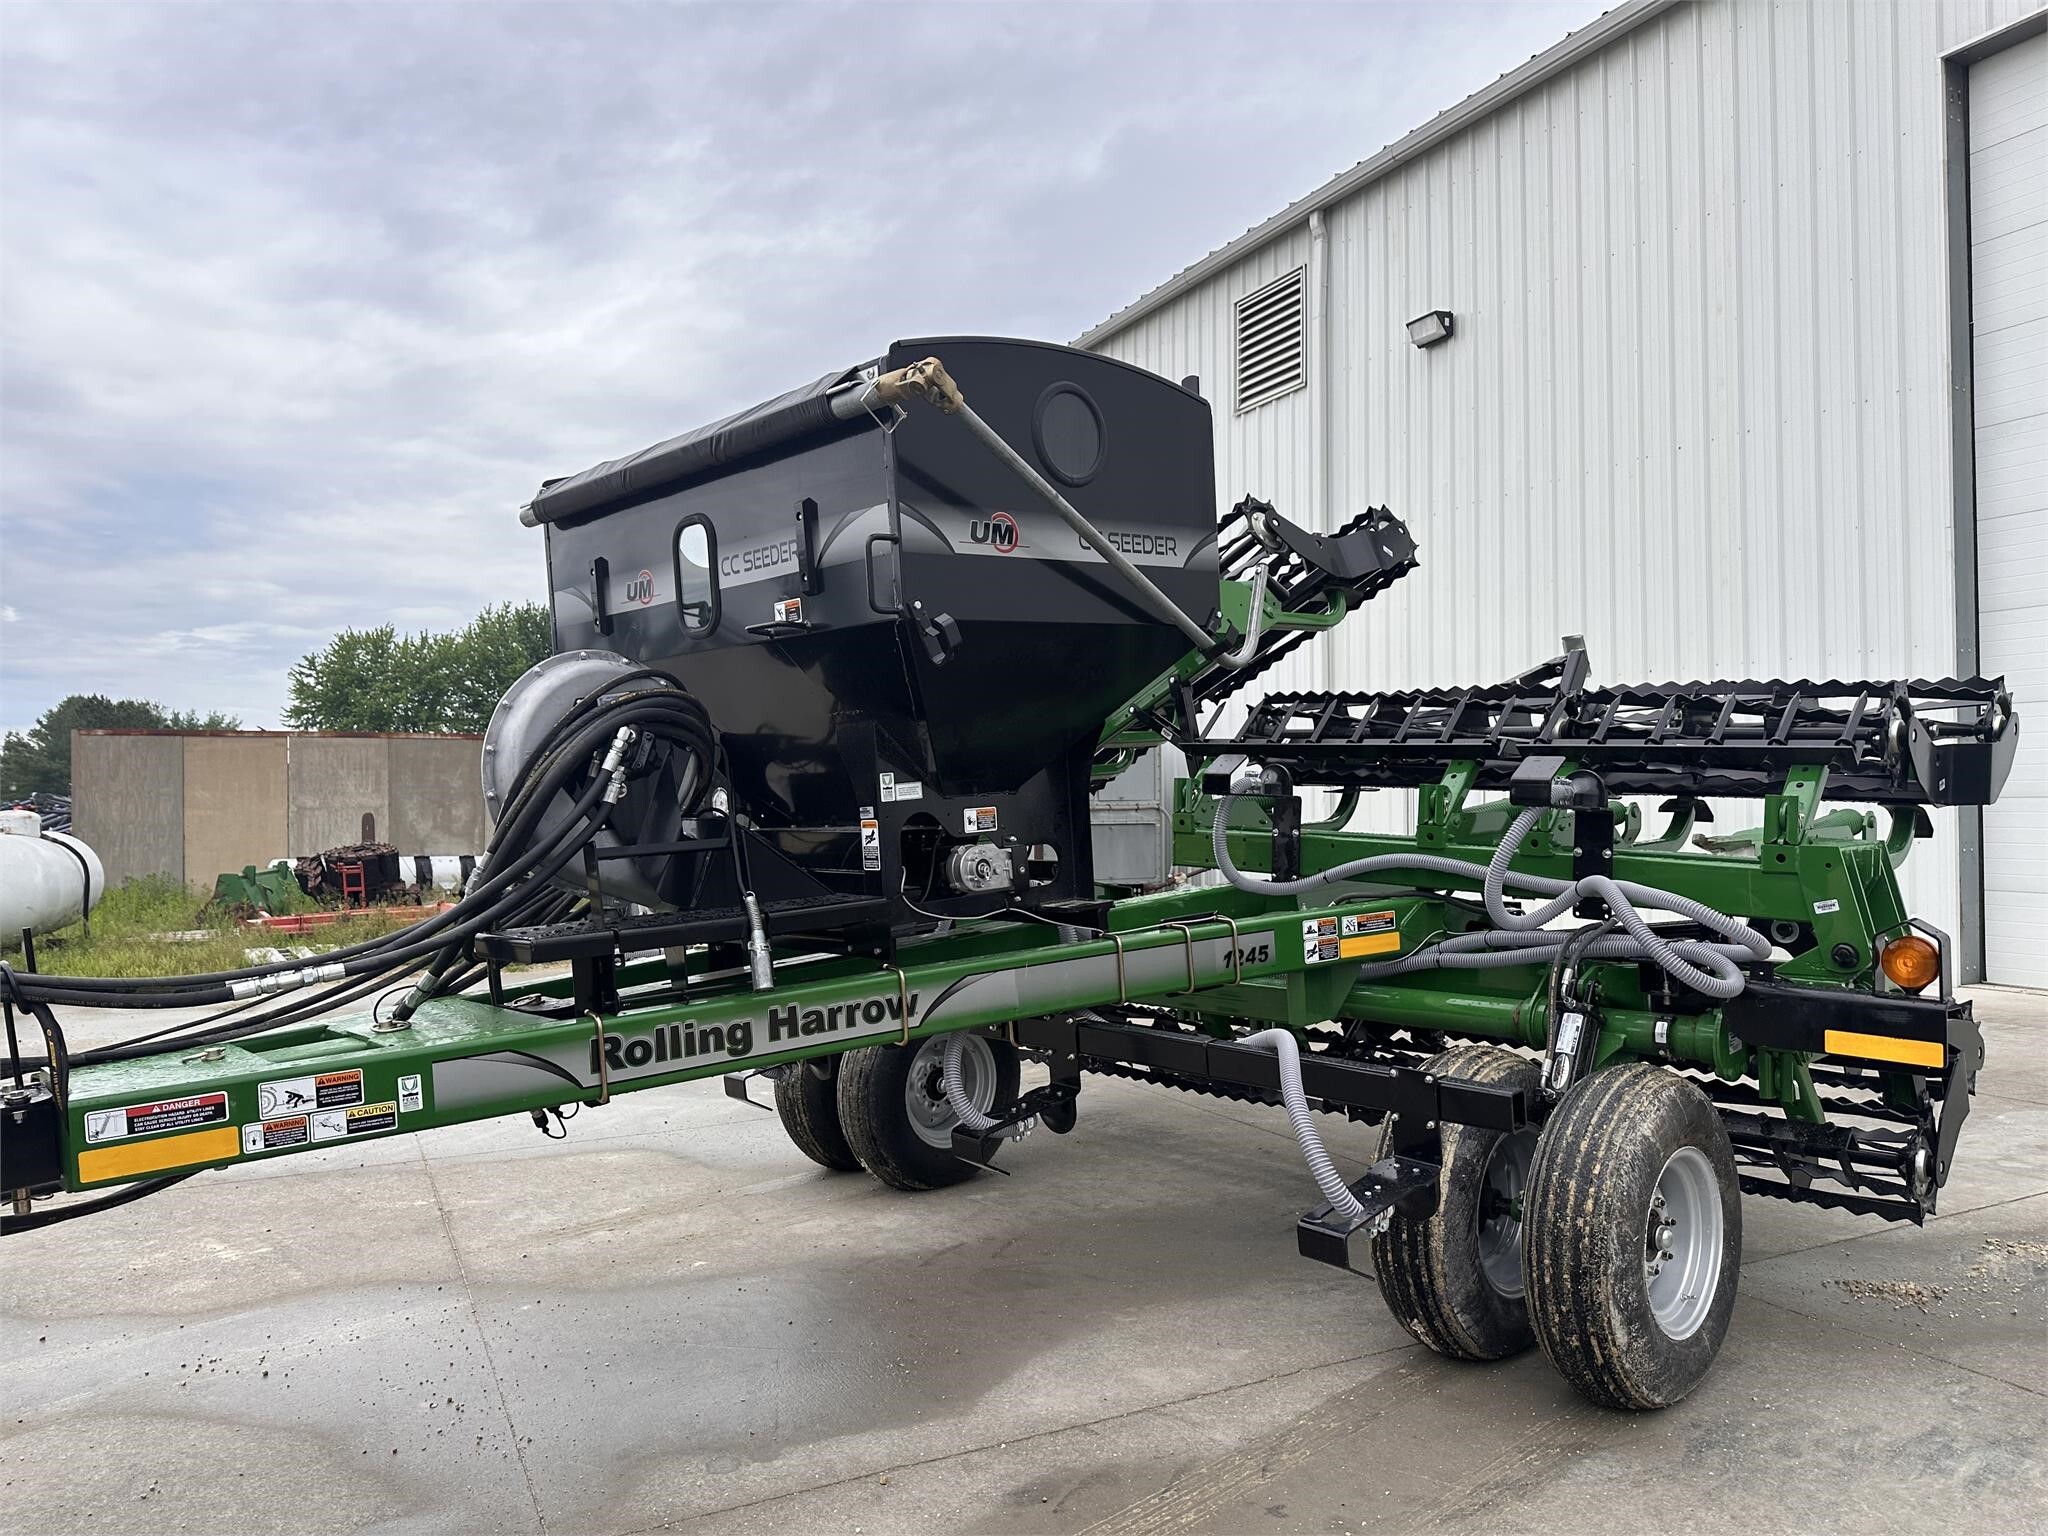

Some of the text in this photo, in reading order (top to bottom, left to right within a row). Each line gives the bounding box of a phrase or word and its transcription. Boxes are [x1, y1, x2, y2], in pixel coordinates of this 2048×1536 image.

[970, 520, 1014, 545] UM
[1109, 532, 1178, 557] SEEDER
[721, 538, 799, 577] CC SEEDER
[626, 580, 651, 601] UM
[590, 993, 919, 1075] Rolling Harrow
[325, 1073, 359, 1084] WARNING
[162, 1099, 201, 1111] DANGER
[357, 1105, 394, 1117] CAUTION
[273, 1118, 305, 1130] WARNING
